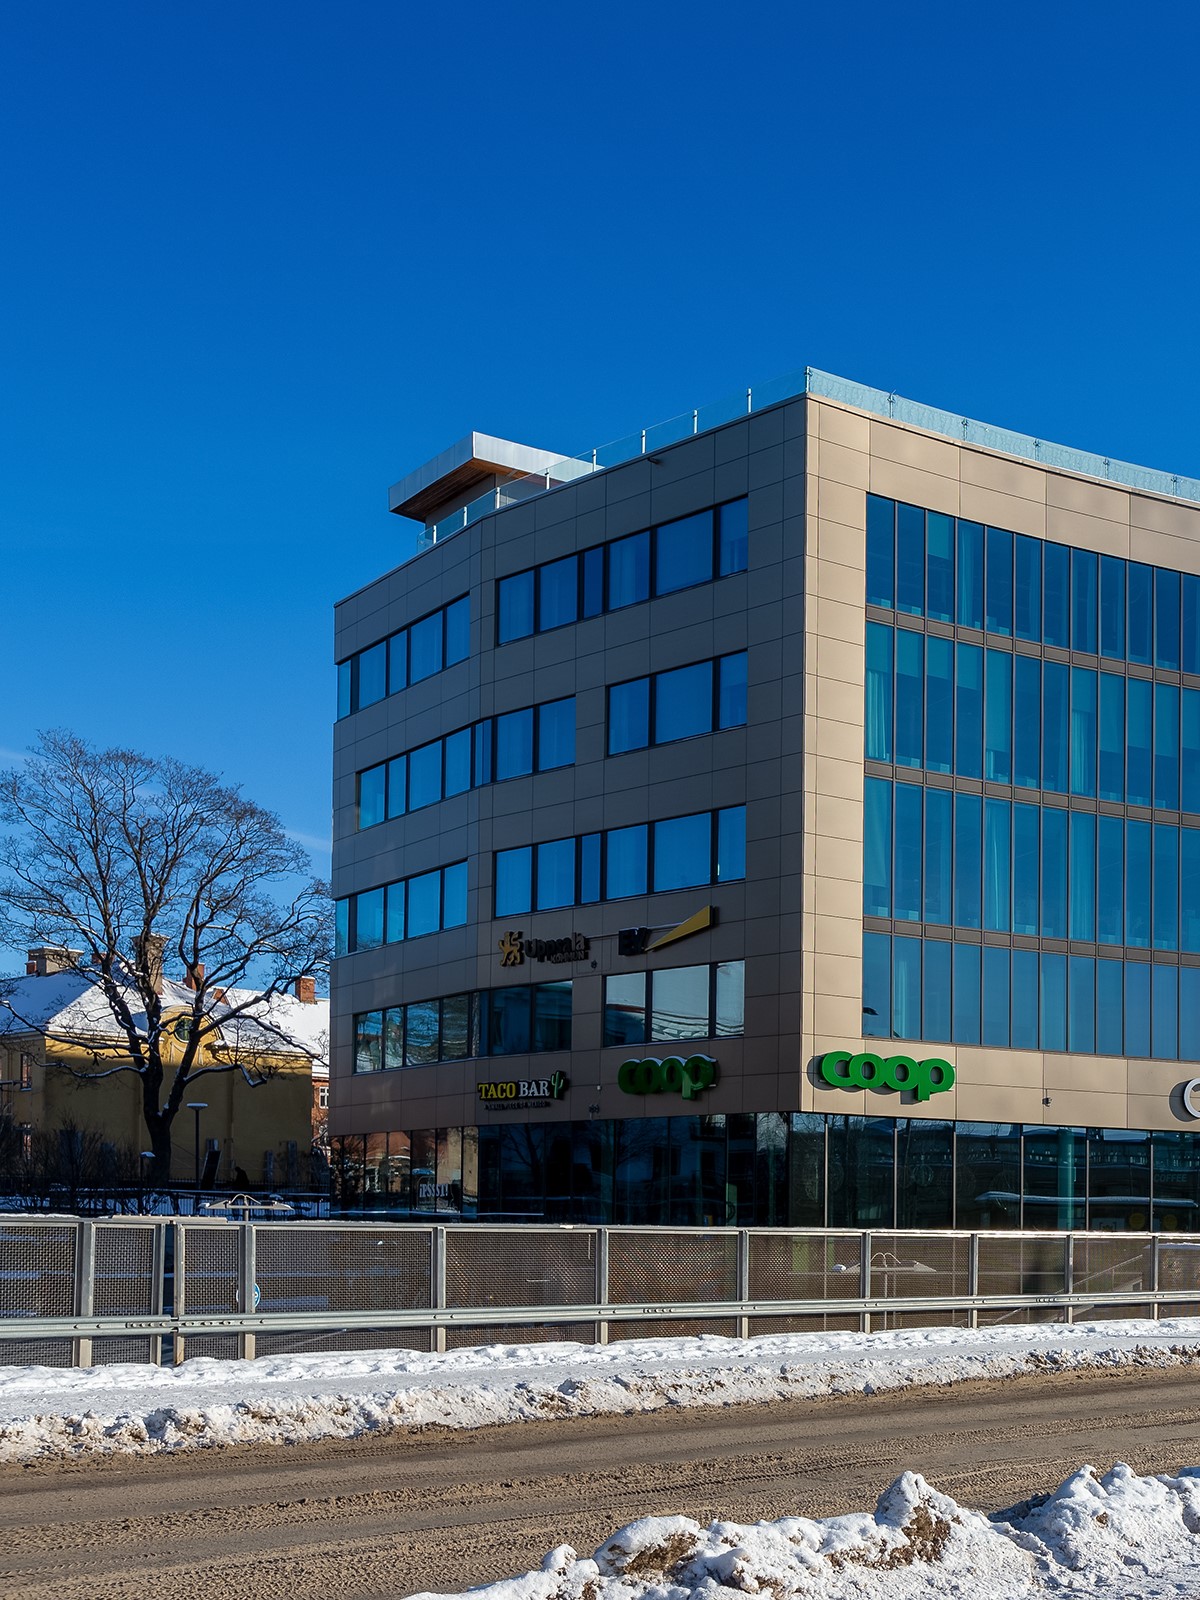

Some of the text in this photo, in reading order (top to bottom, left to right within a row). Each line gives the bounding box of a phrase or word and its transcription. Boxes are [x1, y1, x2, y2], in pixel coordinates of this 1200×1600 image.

[526, 932, 585, 962] Uppsala
[550, 951, 585, 963] KOMMUN
[478, 1080, 550, 1100] TACO BAR
[618, 1054, 716, 1100] coop
[822, 1051, 955, 1101] coop
